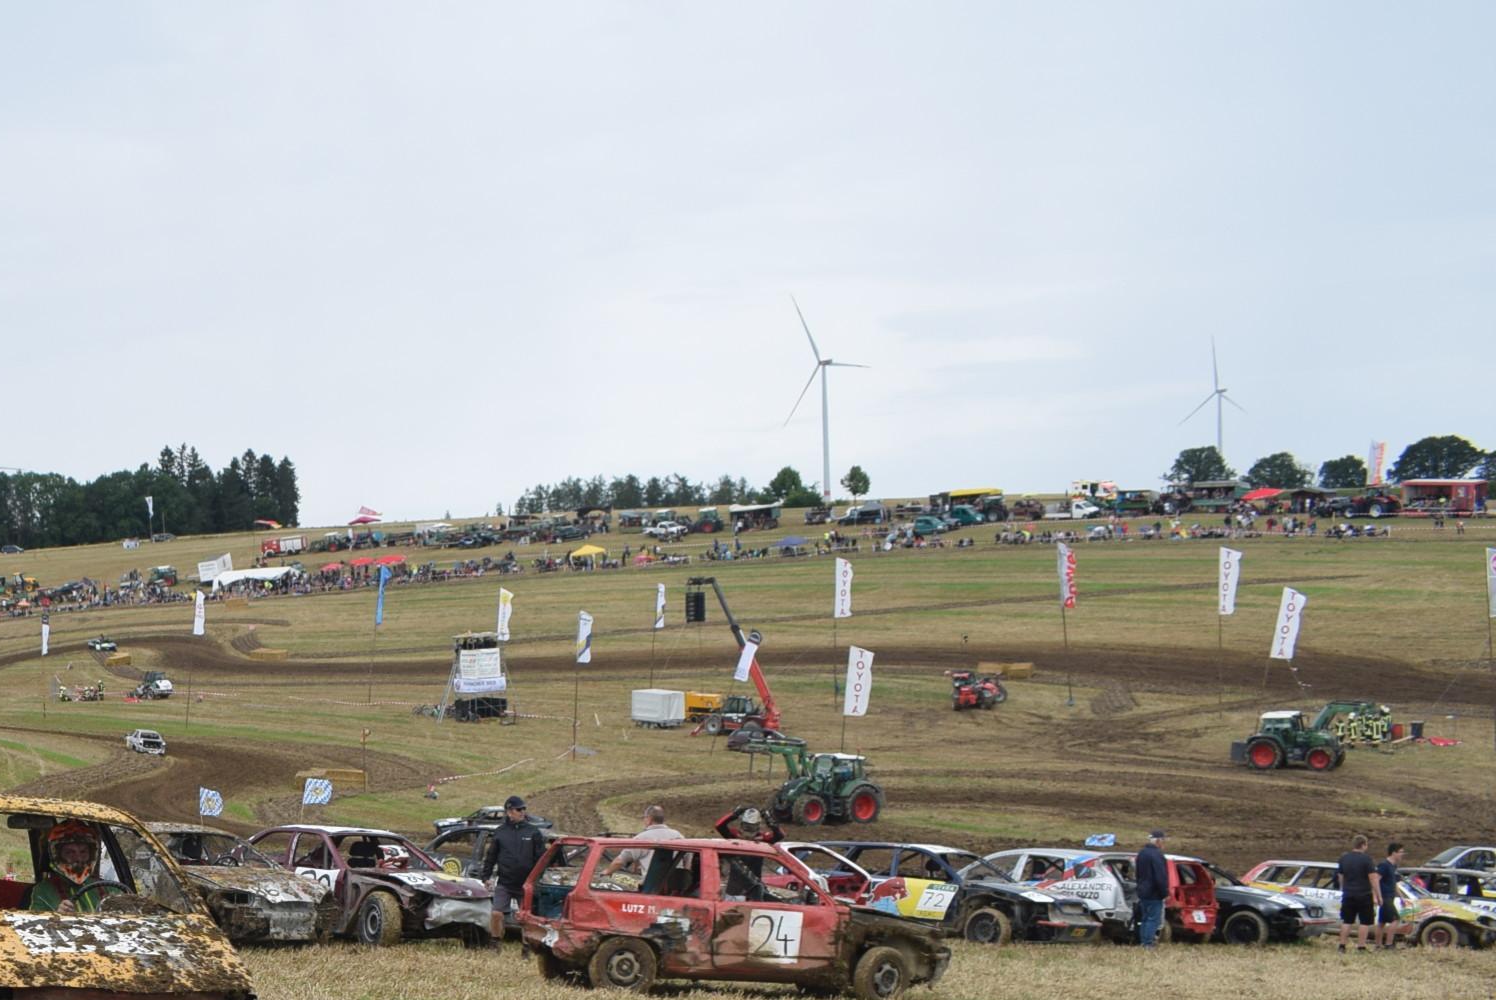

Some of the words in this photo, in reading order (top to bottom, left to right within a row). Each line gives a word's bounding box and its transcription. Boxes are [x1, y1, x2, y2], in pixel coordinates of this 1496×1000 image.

[840, 560, 849, 615] TOYOTA
[1223, 550, 1232, 612] TOYOTA
[1278, 591, 1298, 656] TOYOTA
[851, 650, 865, 713] TOYOTA
[621, 903, 645, 913] LUTZ
[924, 891, 945, 908] 72
[750, 914, 796, 956] 24
